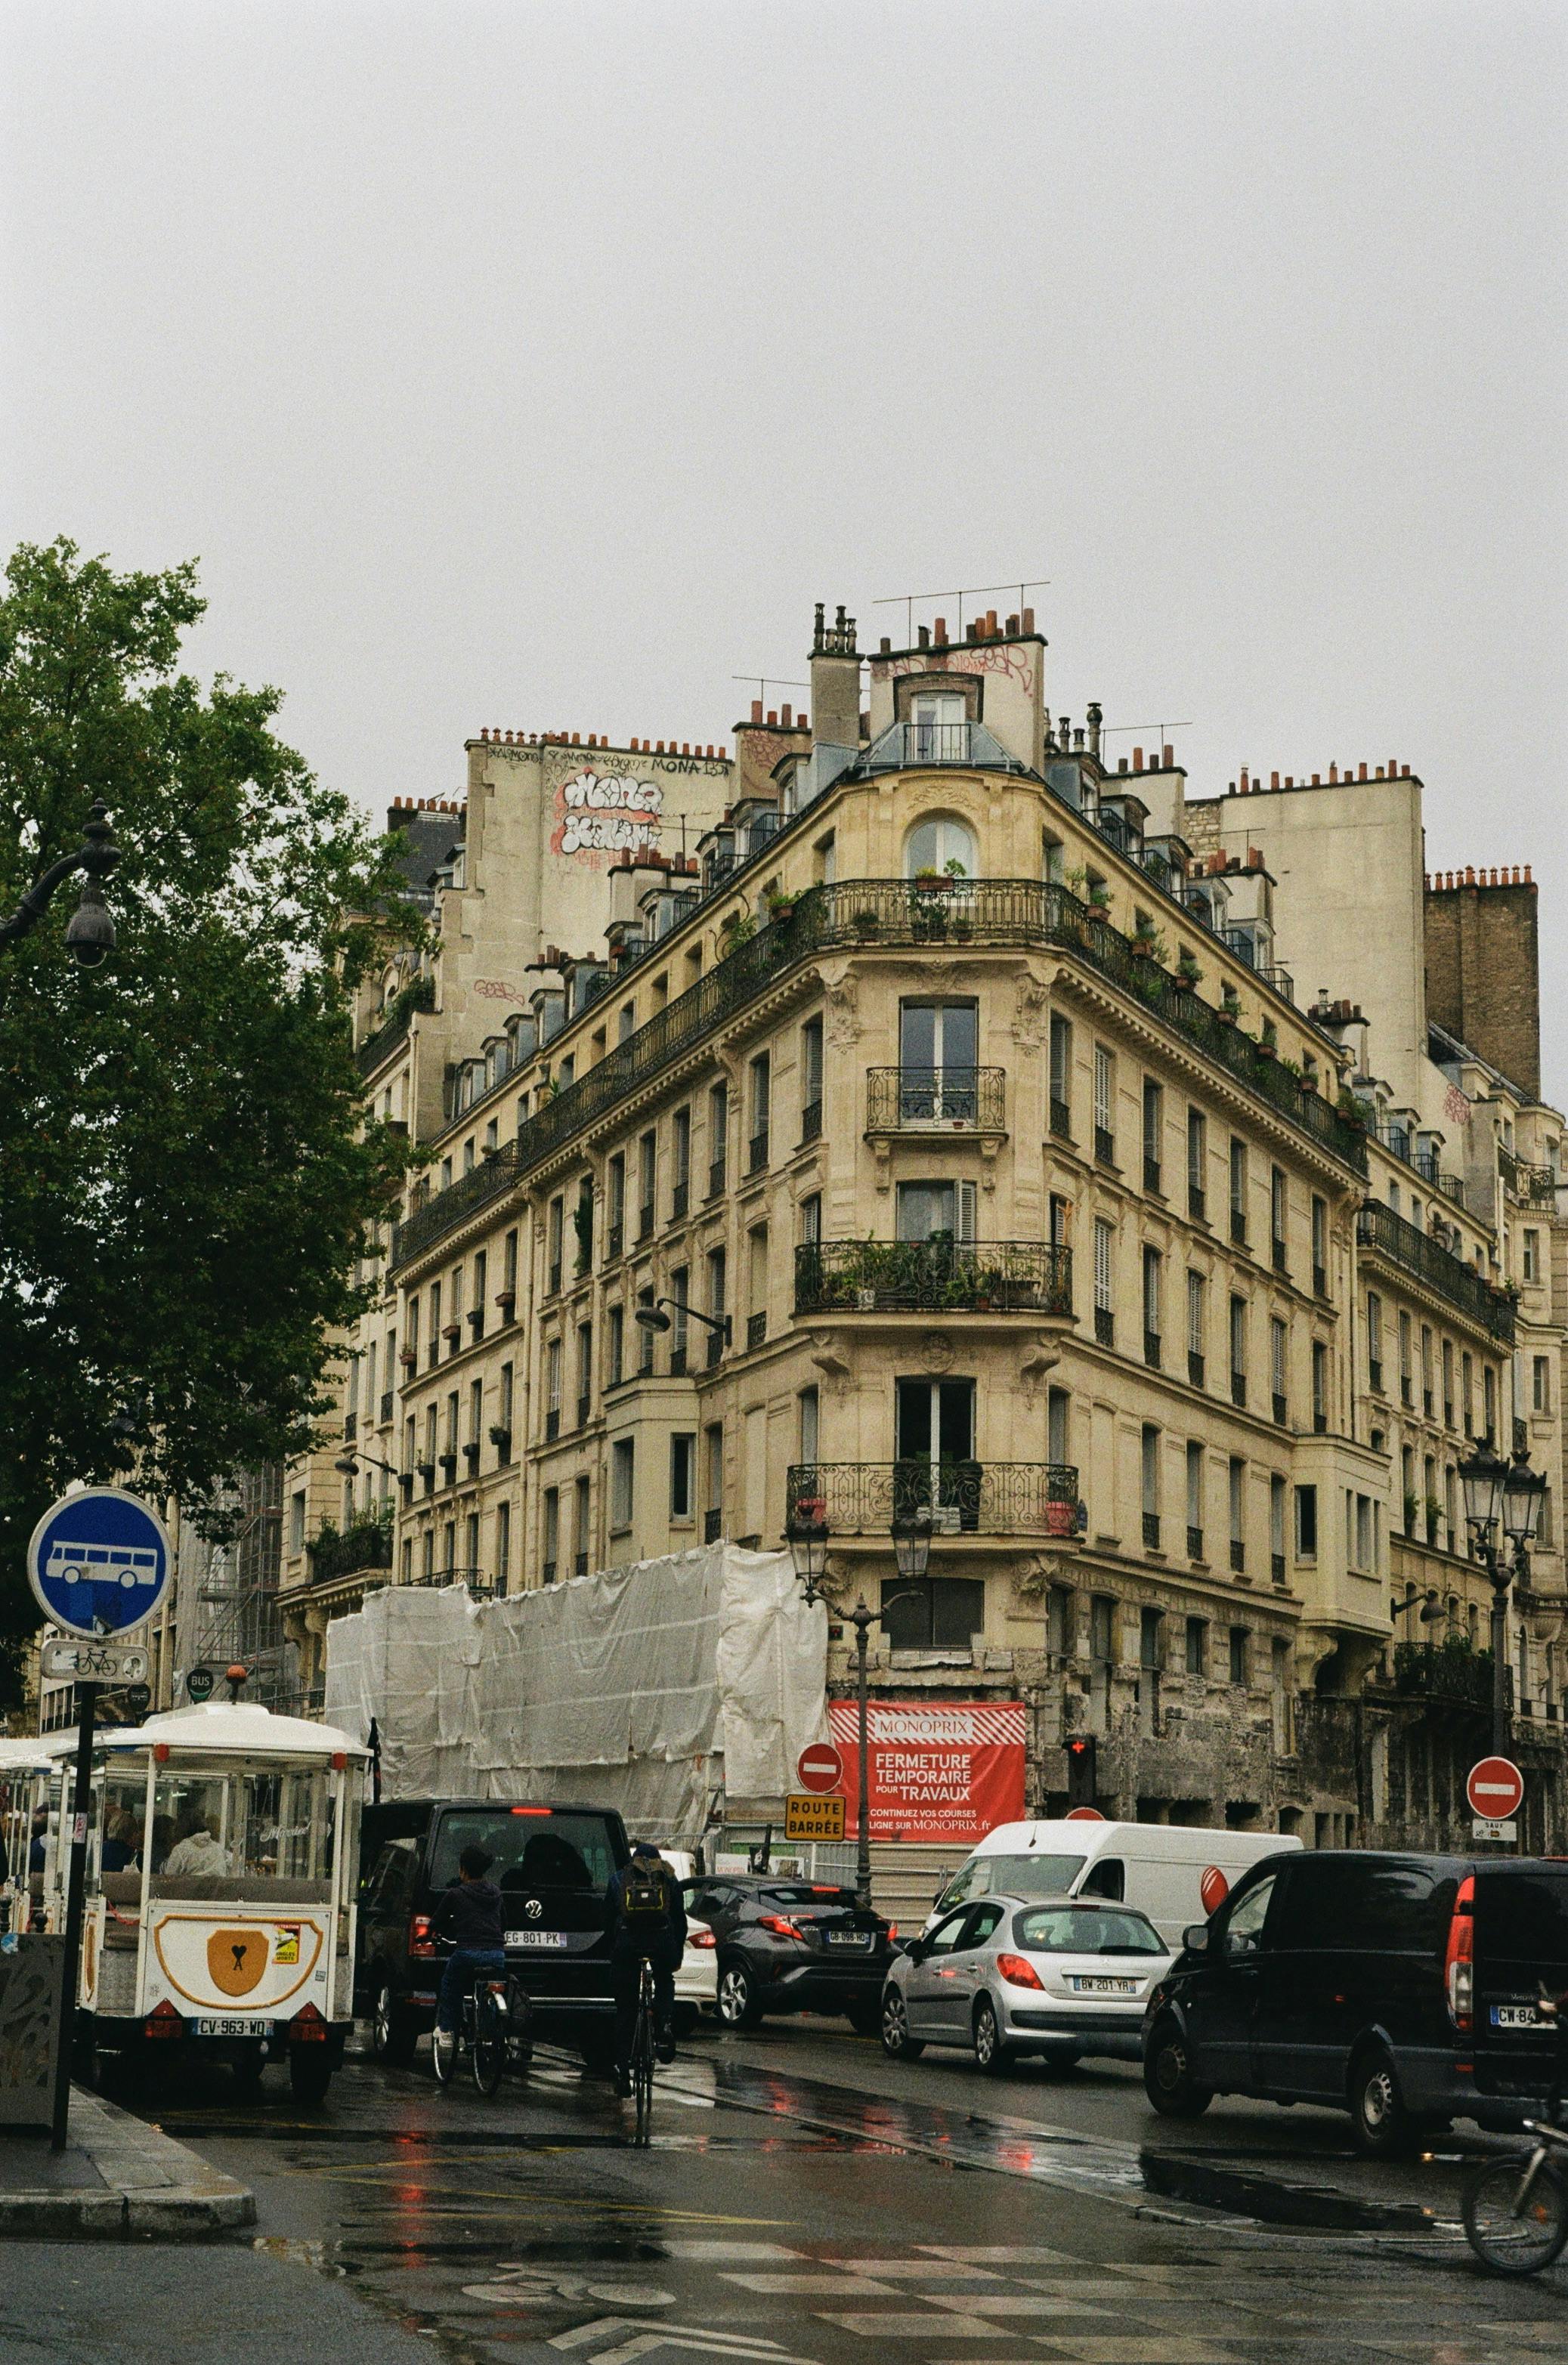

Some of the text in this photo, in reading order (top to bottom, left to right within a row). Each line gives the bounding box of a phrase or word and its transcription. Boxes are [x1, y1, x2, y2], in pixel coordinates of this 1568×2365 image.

[190, 1675, 210, 1686] BUS
[879, 1719, 969, 1735] MONOPRIX
[875, 1752, 971, 1770] FERMETURE
[876, 1769, 972, 1785] TEMPORAIRE
[875, 1785, 971, 1801] POUR TRAVAUX
[790, 1801, 841, 1815] ROUTE
[870, 1808, 977, 1819] CONTINUEZ VOS COURSES
[789, 1819, 841, 1835] BARRÉE
[869, 1821, 893, 1830] LIGNE
[895, 1822, 912, 1830] SUR
